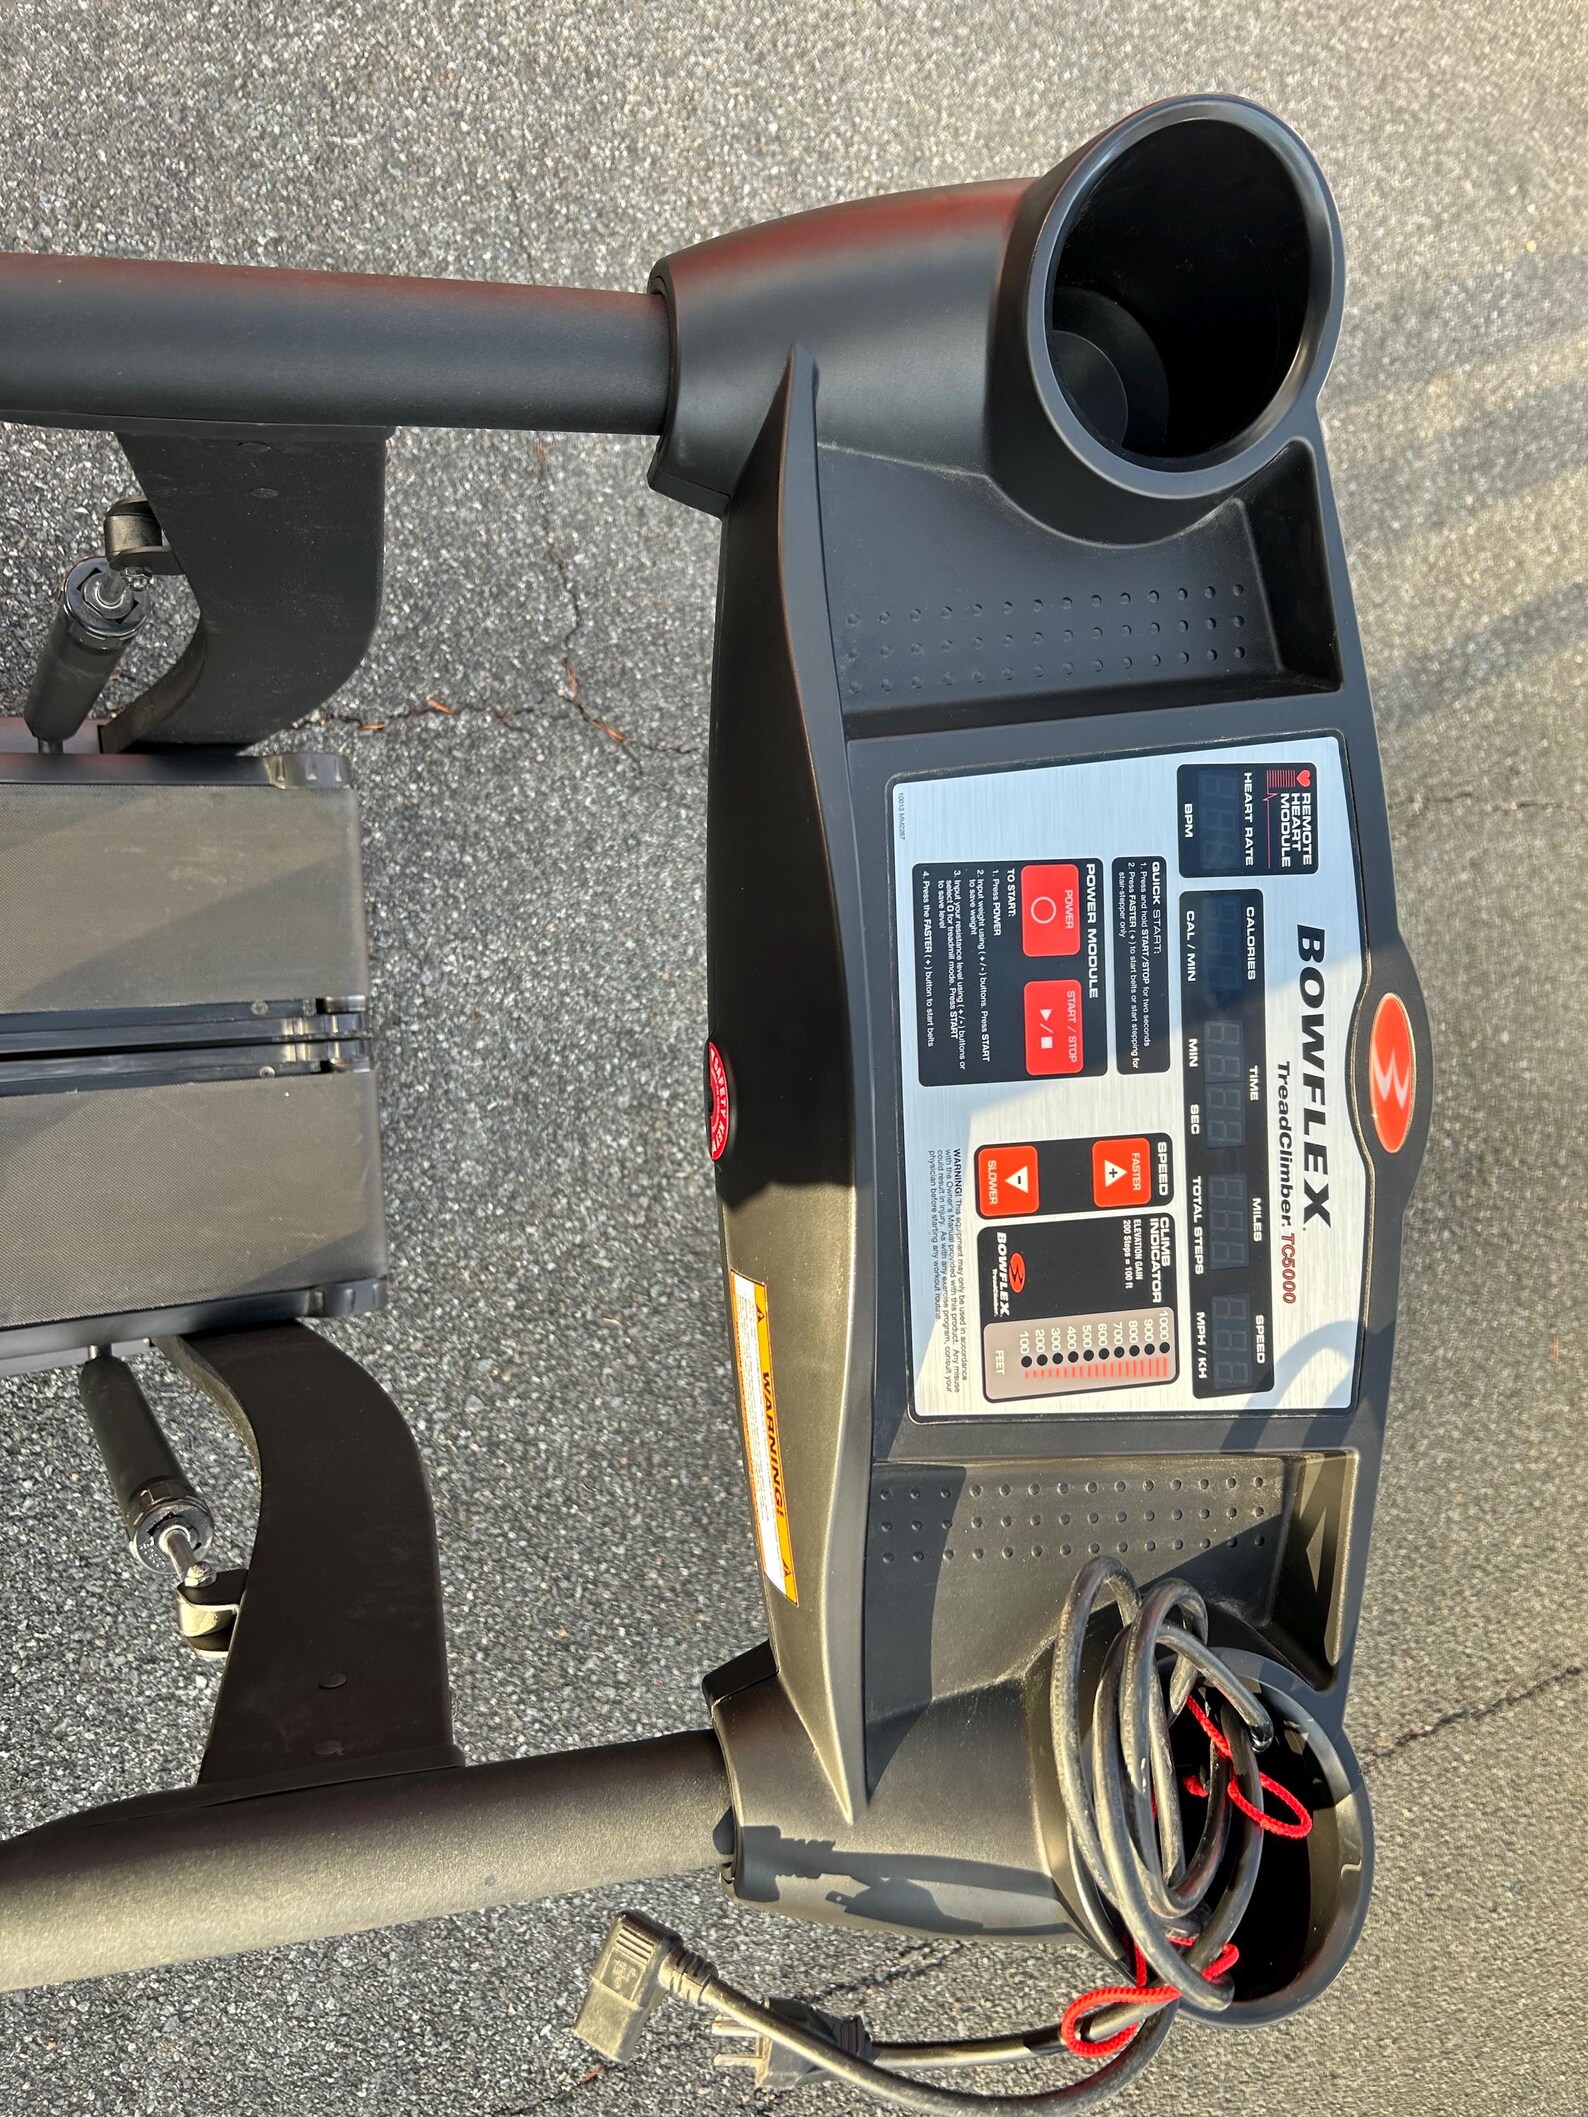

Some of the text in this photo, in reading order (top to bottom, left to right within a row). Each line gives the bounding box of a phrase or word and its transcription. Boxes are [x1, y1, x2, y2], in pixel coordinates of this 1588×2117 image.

[1184, 803, 1193, 838] BPM
[1244, 772, 1254, 866] HEART RATE
[1280, 793, 1291, 868] MODULE
[1291, 792, 1301, 852] HEART
[1301, 792, 1312, 865] REMOTE
[923, 871, 930, 879] 4.
[938, 880, 946, 889] to
[969, 879, 977, 888] to
[1128, 871, 1136, 893] Press
[923, 881, 931, 903] Press
[992, 869, 1001, 936] 1. Press POWER
[1007, 868, 1016, 917] TO START:
[1118, 871, 1128, 938] stair-stepper only
[939, 910, 947, 928] level
[968, 909, 978, 935] weight
[1065, 890, 1073, 929] POWER
[1129, 894, 1137, 927] FASTER
[1141, 910, 1149, 927] hold
[1152, 861, 1161, 954] QUICK START:
[924, 919, 933, 953] FASTER
[1086, 863, 1098, 998] POWER MODULE
[1186, 910, 1196, 981] CAL MIN
[1246, 906, 1256, 980] CALORIES
[946, 880, 958, 1039] select for treadmill mode. Press START
[975, 869, 990, 1061] 2. Input weight using buttons. Press START
[1130, 946, 1137, 954] to
[1130, 956, 1138, 973] start
[1142, 929, 1150, 985] START/STOP
[926, 971, 934, 997] button
[952, 870, 967, 1070] 3. Input your resistance level using buttons or
[927, 998, 934, 1007] to
[1131, 995, 1137, 1003] or
[1131, 1004, 1139, 1022] start
[927, 1008, 935, 1026] start
[1067, 990, 1077, 1063] START STOP
[1143, 1014, 1151, 1046] seconds
[927, 1028, 935, 1047] belts
[1130, 1023, 1140, 1056] stepping
[1188, 1038, 1198, 1067] MIN
[1132, 1058, 1140, 1068] for
[1297, 924, 1331, 1229] BOWFLEX
[1249, 1065, 1259, 1101] TIME
[714, 1057, 726, 1149] SAFETY KEY
[1190, 1104, 1200, 1134] SEC
[937, 1150, 945, 1171] could
[946, 1166, 954, 1179] the
[954, 1148, 963, 1197] WARNING!
[1132, 1152, 1141, 1191] FASTER
[1158, 1141, 1168, 1196] SPEED
[938, 1173, 946, 1194] result
[988, 1159, 998, 1204] SLOWER
[1278, 1060, 1296, 1304] TreadClimber TC5000
[947, 1181, 955, 1213] Owner's
[928, 1150, 942, 1291] physician before starting any workout
[948, 1215, 956, 1243] Manual
[1123, 1219, 1131, 1234] 200
[1192, 1176, 1204, 1275] TOTAL STEPS
[1252, 1198, 1262, 1241] MILES
[941, 1231, 948, 1243] As
[941, 1244, 949, 1259] with
[954, 1217, 965, 1257] equipment
[1123, 1235, 1132, 1257] Steps
[1133, 1219, 1143, 1280] ELEVATION GAIN
[1160, 1217, 1170, 1267] CLIMB
[940, 1261, 948, 1274] any
[947, 1244, 958, 1278] provided
[956, 1259, 964, 1275] may
[997, 1232, 1010, 1316] BOWFLEX
[1150, 1219, 1161, 1303] INDICATOR
[942, 1276, 951, 1308] exercise
[957, 1277, 966, 1293] only
[959, 1295, 967, 1305] be
[951, 1297, 959, 1311] this
[960, 1307, 968, 1326] used
[1051, 1327, 1060, 1351] 300
[1067, 1326, 1076, 1349] 400
[1082, 1324, 1092, 1348] 500
[1098, 1323, 1108, 1346] 600
[1113, 1321, 1123, 1345] 700
[1129, 1320, 1138, 1343] 800
[1144, 1318, 1154, 1341] 900
[1159, 1310, 1169, 1340] 1000
[1255, 1314, 1265, 1364] SPEED
[1019, 1330, 1029, 1354] 100
[1036, 1329, 1045, 1353] 200
[1196, 1312, 1207, 1379] MPH KH
[945, 1346, 953, 1374] consult
[951, 1349, 961, 1364] Any
[961, 1336, 970, 1381] accordance
[995, 1350, 1005, 1375] FEET
[945, 1376, 953, 1393] your
[954, 1366, 962, 1393] misuse
[763, 1372, 784, 1517] WARNING!
